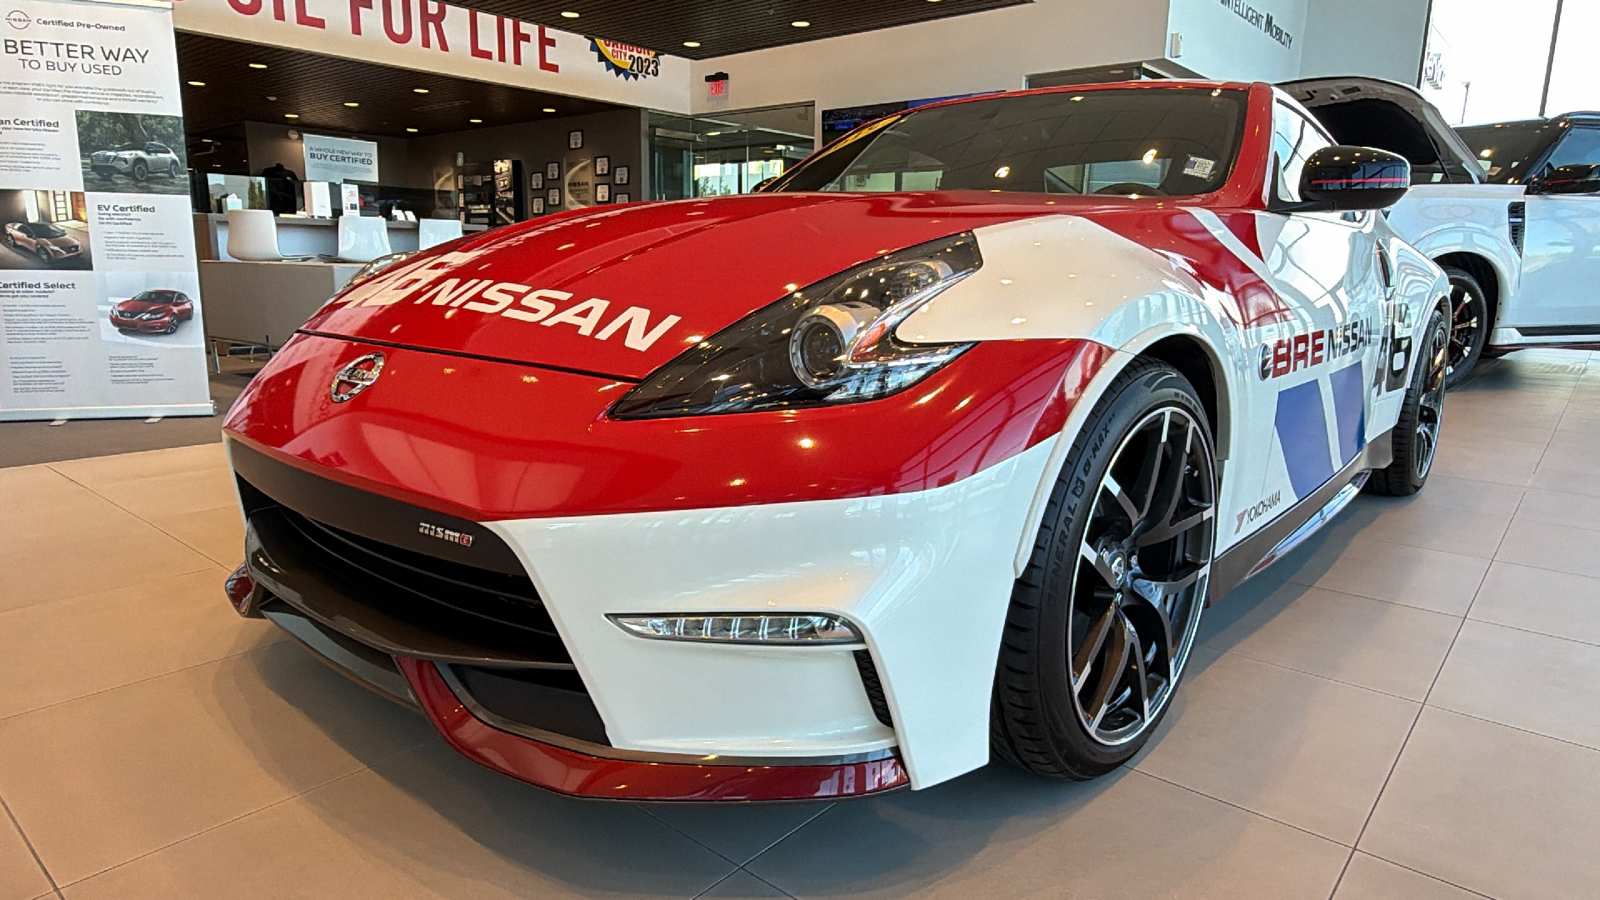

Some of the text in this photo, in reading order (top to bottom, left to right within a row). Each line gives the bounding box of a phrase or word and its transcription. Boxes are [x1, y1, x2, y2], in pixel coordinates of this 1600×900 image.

[36, 18, 126, 32] Certified Pre-Owned
[469, 9, 559, 73] LIFE
[4, 39, 149, 63] BETTER WAY
[611, 48, 628, 61] CITY
[18, 58, 122, 76] TO BUY USED
[628, 54, 659, 77] 2023
[13, 118, 60, 128] Certified
[310, 152, 373, 165] BUY CERTIFIED
[97, 204, 156, 213] EV Certified
[43, 282, 77, 290] Select
[413, 278, 682, 352] NISSAN
[1272, 329, 1325, 379] BRE
[1327, 315, 1373, 362] NISSAN
